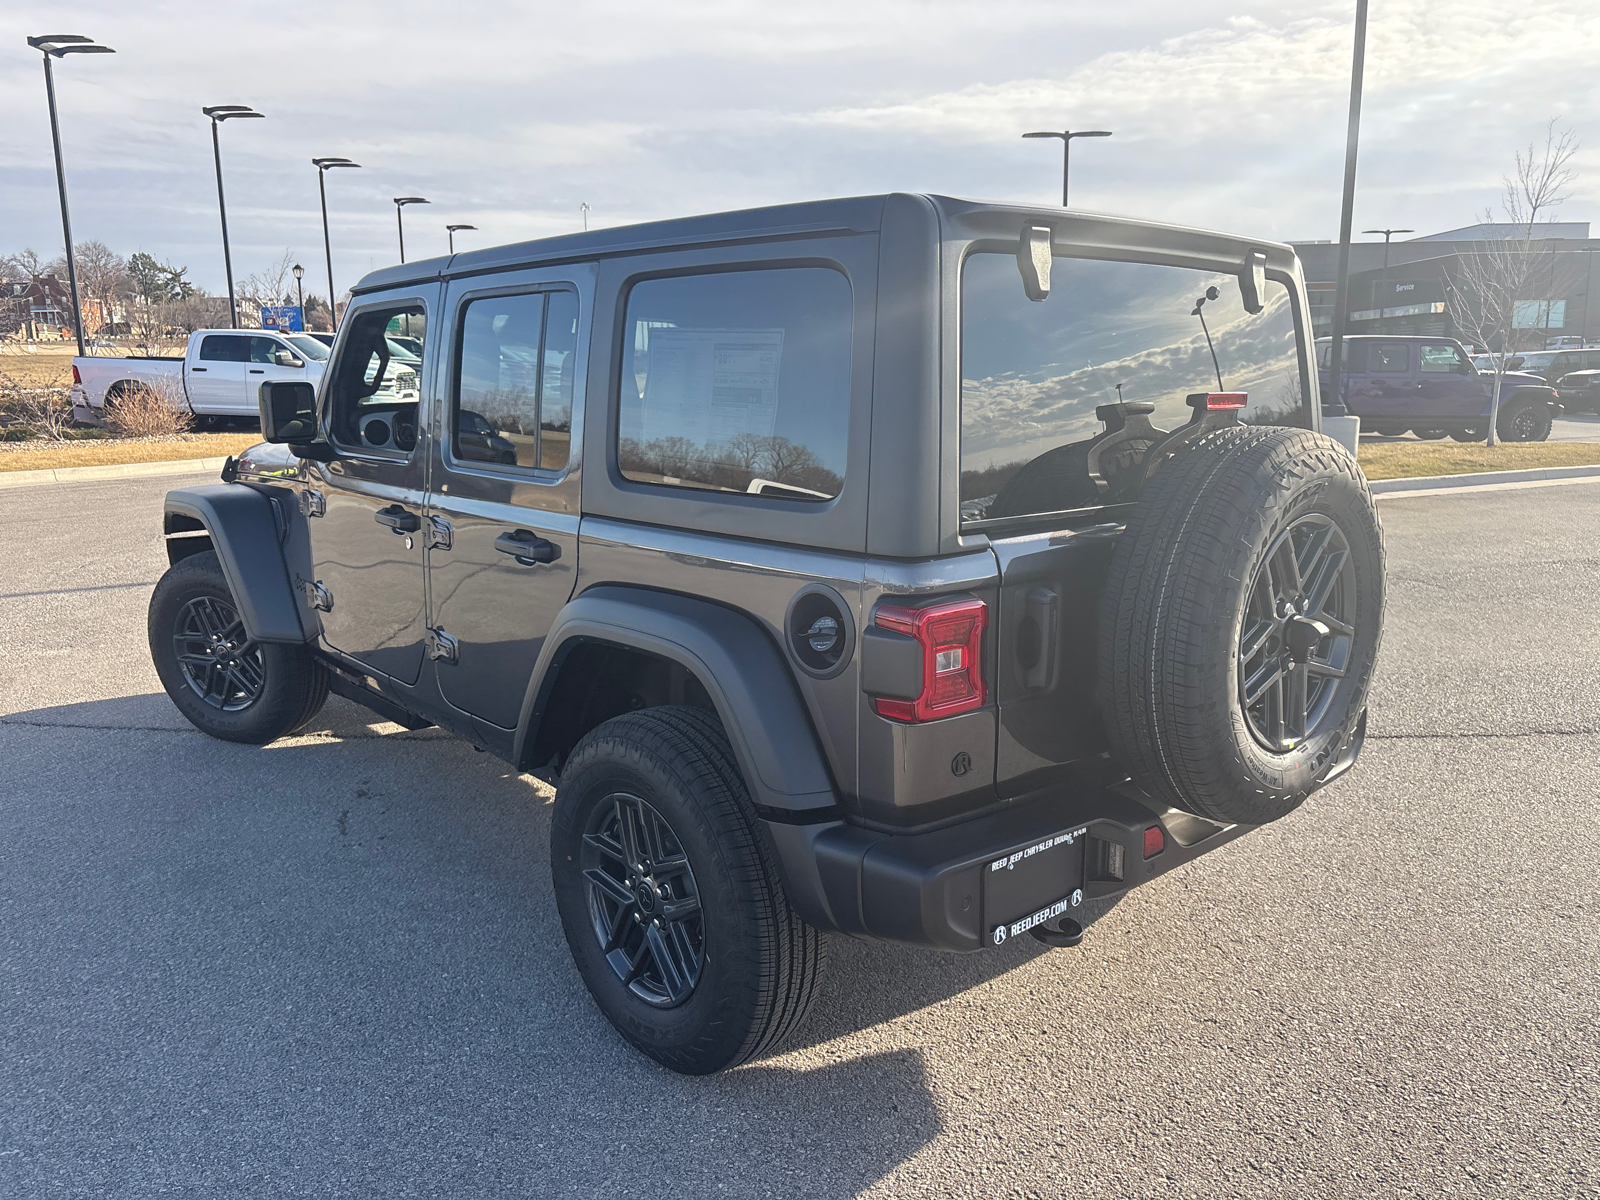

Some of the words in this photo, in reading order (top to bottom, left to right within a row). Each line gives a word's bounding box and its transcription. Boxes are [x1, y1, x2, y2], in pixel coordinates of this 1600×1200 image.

[1395, 283, 1415, 293] Service
[991, 857, 1008, 872] REED
[1009, 851, 1023, 864] JEEP
[1024, 839, 1054, 858] CHRYSLER
[1011, 899, 1068, 938] REEDJEEP.COM
